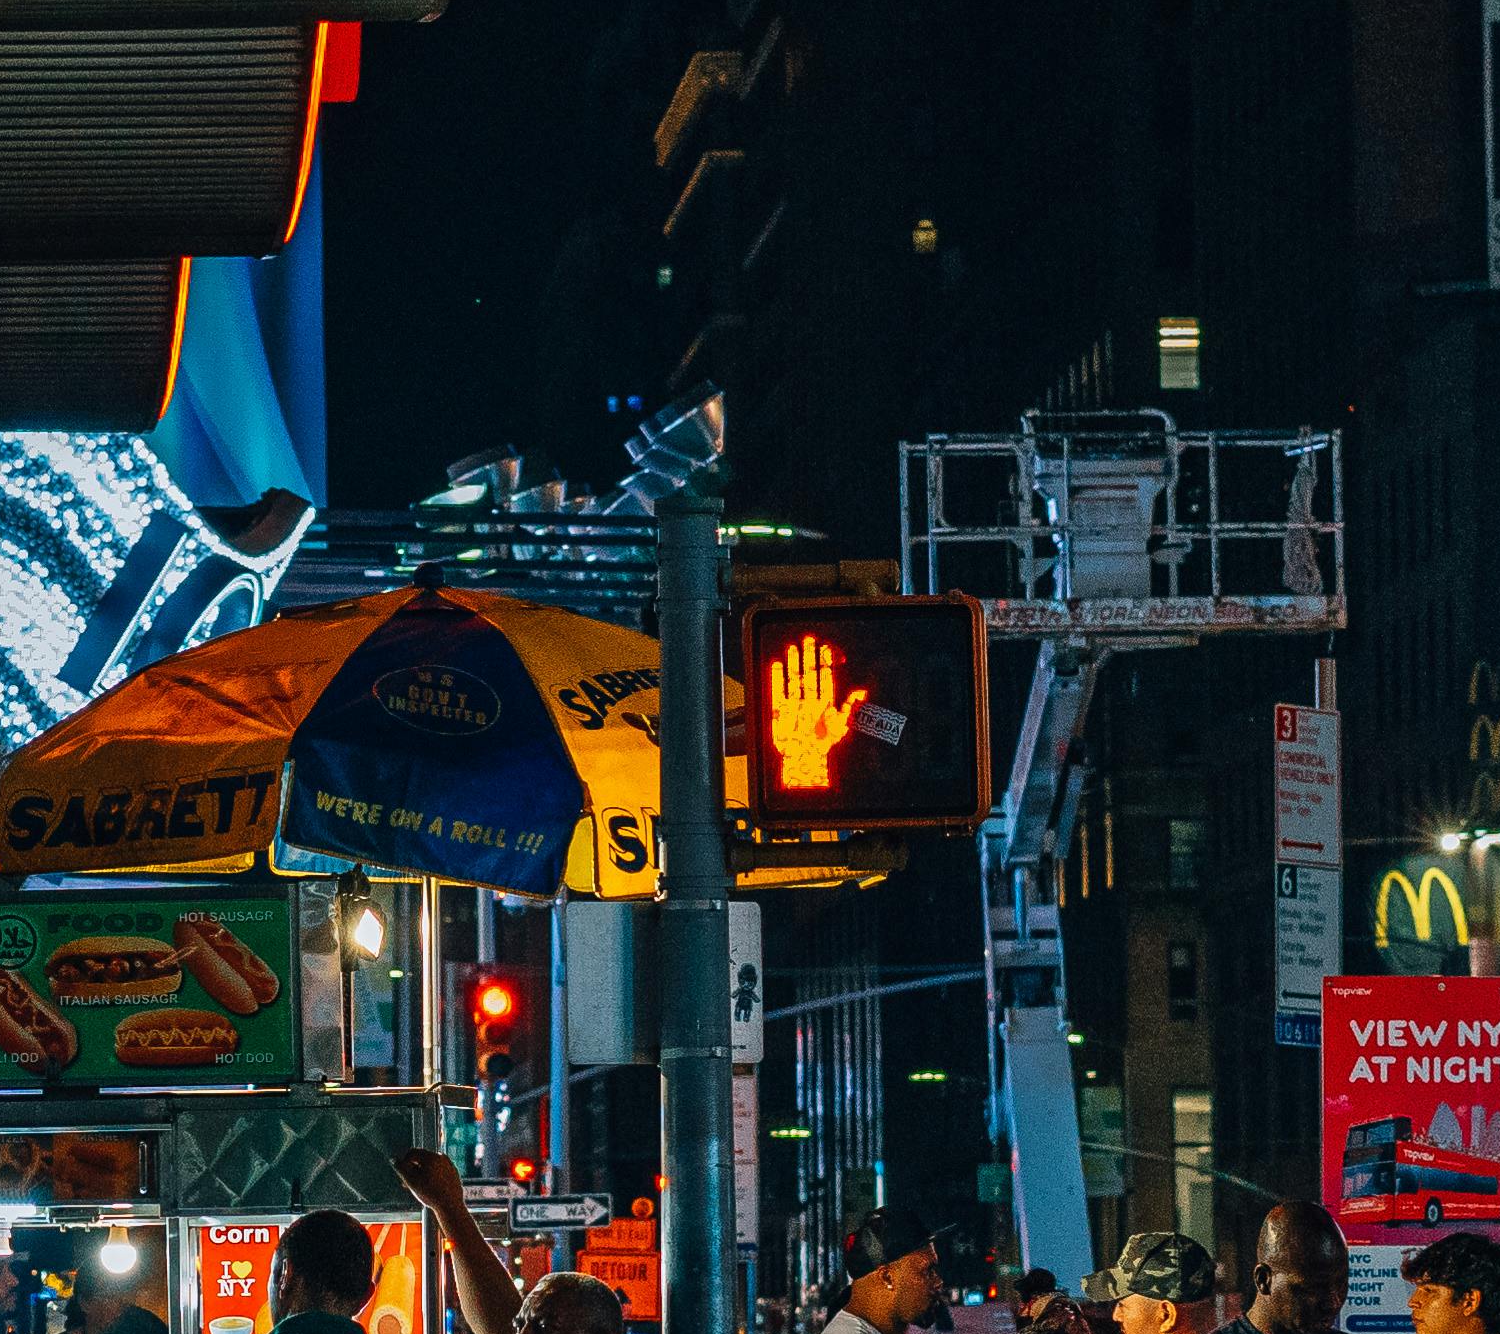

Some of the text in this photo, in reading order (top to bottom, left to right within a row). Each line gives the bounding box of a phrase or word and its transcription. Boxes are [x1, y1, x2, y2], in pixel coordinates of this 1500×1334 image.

[5, 769, 277, 852] SABRETT
[314, 788, 383, 828] WE'RE
[389, 806, 423, 831] ON
[428, 815, 444, 837] A
[449, 817, 503, 849] ROLL
[46, 912, 165, 934] FOOD
[178, 911, 208, 924] HOT
[59, 994, 110, 1007] ITALIAN
[1349, 1019, 1448, 1048] VIEW
[214, 1052, 243, 1064] HOT
[1349, 1055, 1397, 1084] AT
[519, 1204, 596, 1219] ONE WAY
[208, 1225, 271, 1244] Corn
[220, 1260, 232, 1280] I
[590, 1262, 648, 1282] DETOUR
[216, 1278, 256, 1298] NY
